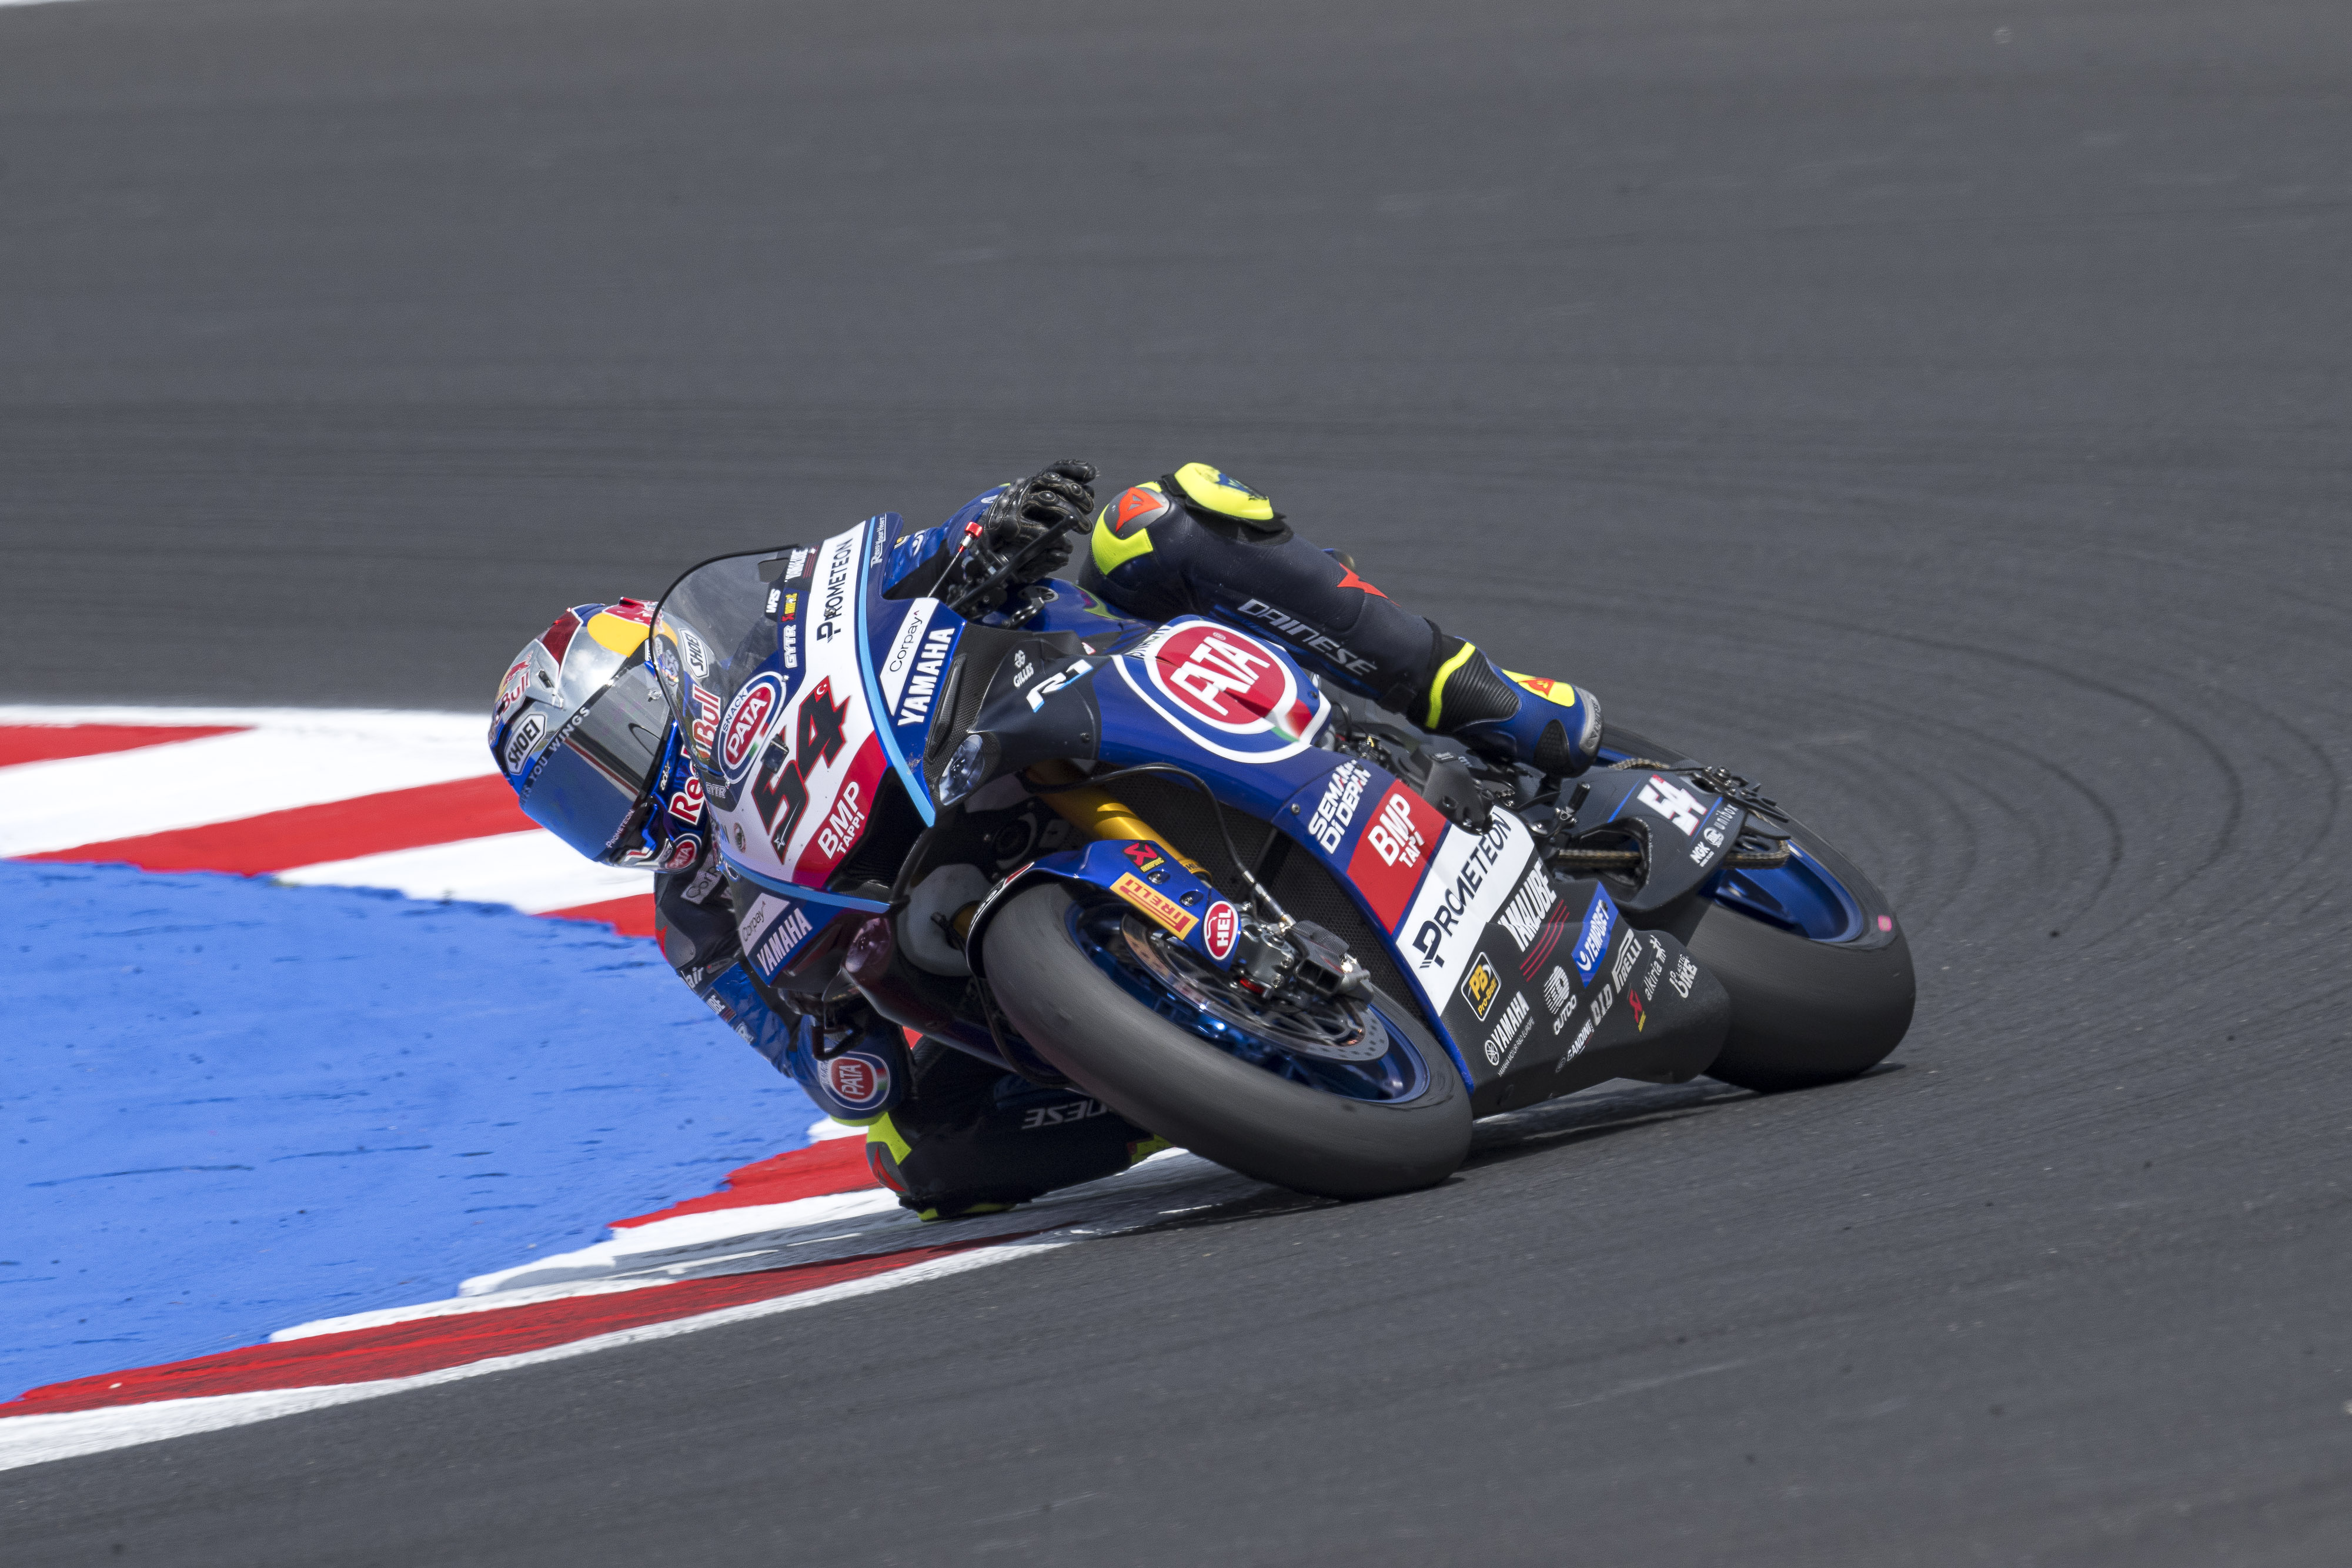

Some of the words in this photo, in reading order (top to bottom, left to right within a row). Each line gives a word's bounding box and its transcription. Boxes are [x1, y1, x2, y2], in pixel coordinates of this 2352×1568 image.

[684, 631, 704, 671] SHOEI
[784, 624, 798, 668] GYTR
[1238, 599, 1377, 676] DAINESE
[897, 628, 956, 726] YAMAHA
[1013, 662, 1034, 688] GILLES
[723, 688, 749, 733] SNACK
[727, 698, 767, 758] PATA
[507, 718, 540, 770] SHOEI
[529, 756, 548, 783] YOU
[549, 707, 590, 753] WINGS
[751, 675, 851, 865] 54
[817, 781, 860, 860] BMP
[1637, 774, 1708, 836] 54
[1713, 803, 1739, 830] unibox
[606, 808, 635, 848] PROMETEON
[837, 811, 865, 854] TAPPI
[1368, 794, 1415, 867] BMP
[1689, 841, 1710, 864] NGK
[686, 865, 721, 899] Corp
[1412, 811, 1512, 969] PROMETEON
[1119, 879, 1191, 933] PIRELLI
[1217, 908, 1233, 948] HEL
[1498, 860, 1557, 952] YAMALUBE
[756, 907, 813, 976] YAMAHA
[1612, 928, 1642, 994] PIRELLI
[1469, 964, 1489, 1001] PB
[1645, 959, 1663, 1001] alkiria
[1491, 991, 1530, 1054] YAMAHA
[1566, 1021, 1592, 1062] GANDINI
[839, 1064, 864, 1095] PATA
[1498, 1059, 1510, 1077] YAMAHA
[1021, 1098, 1107, 1129] NESE
